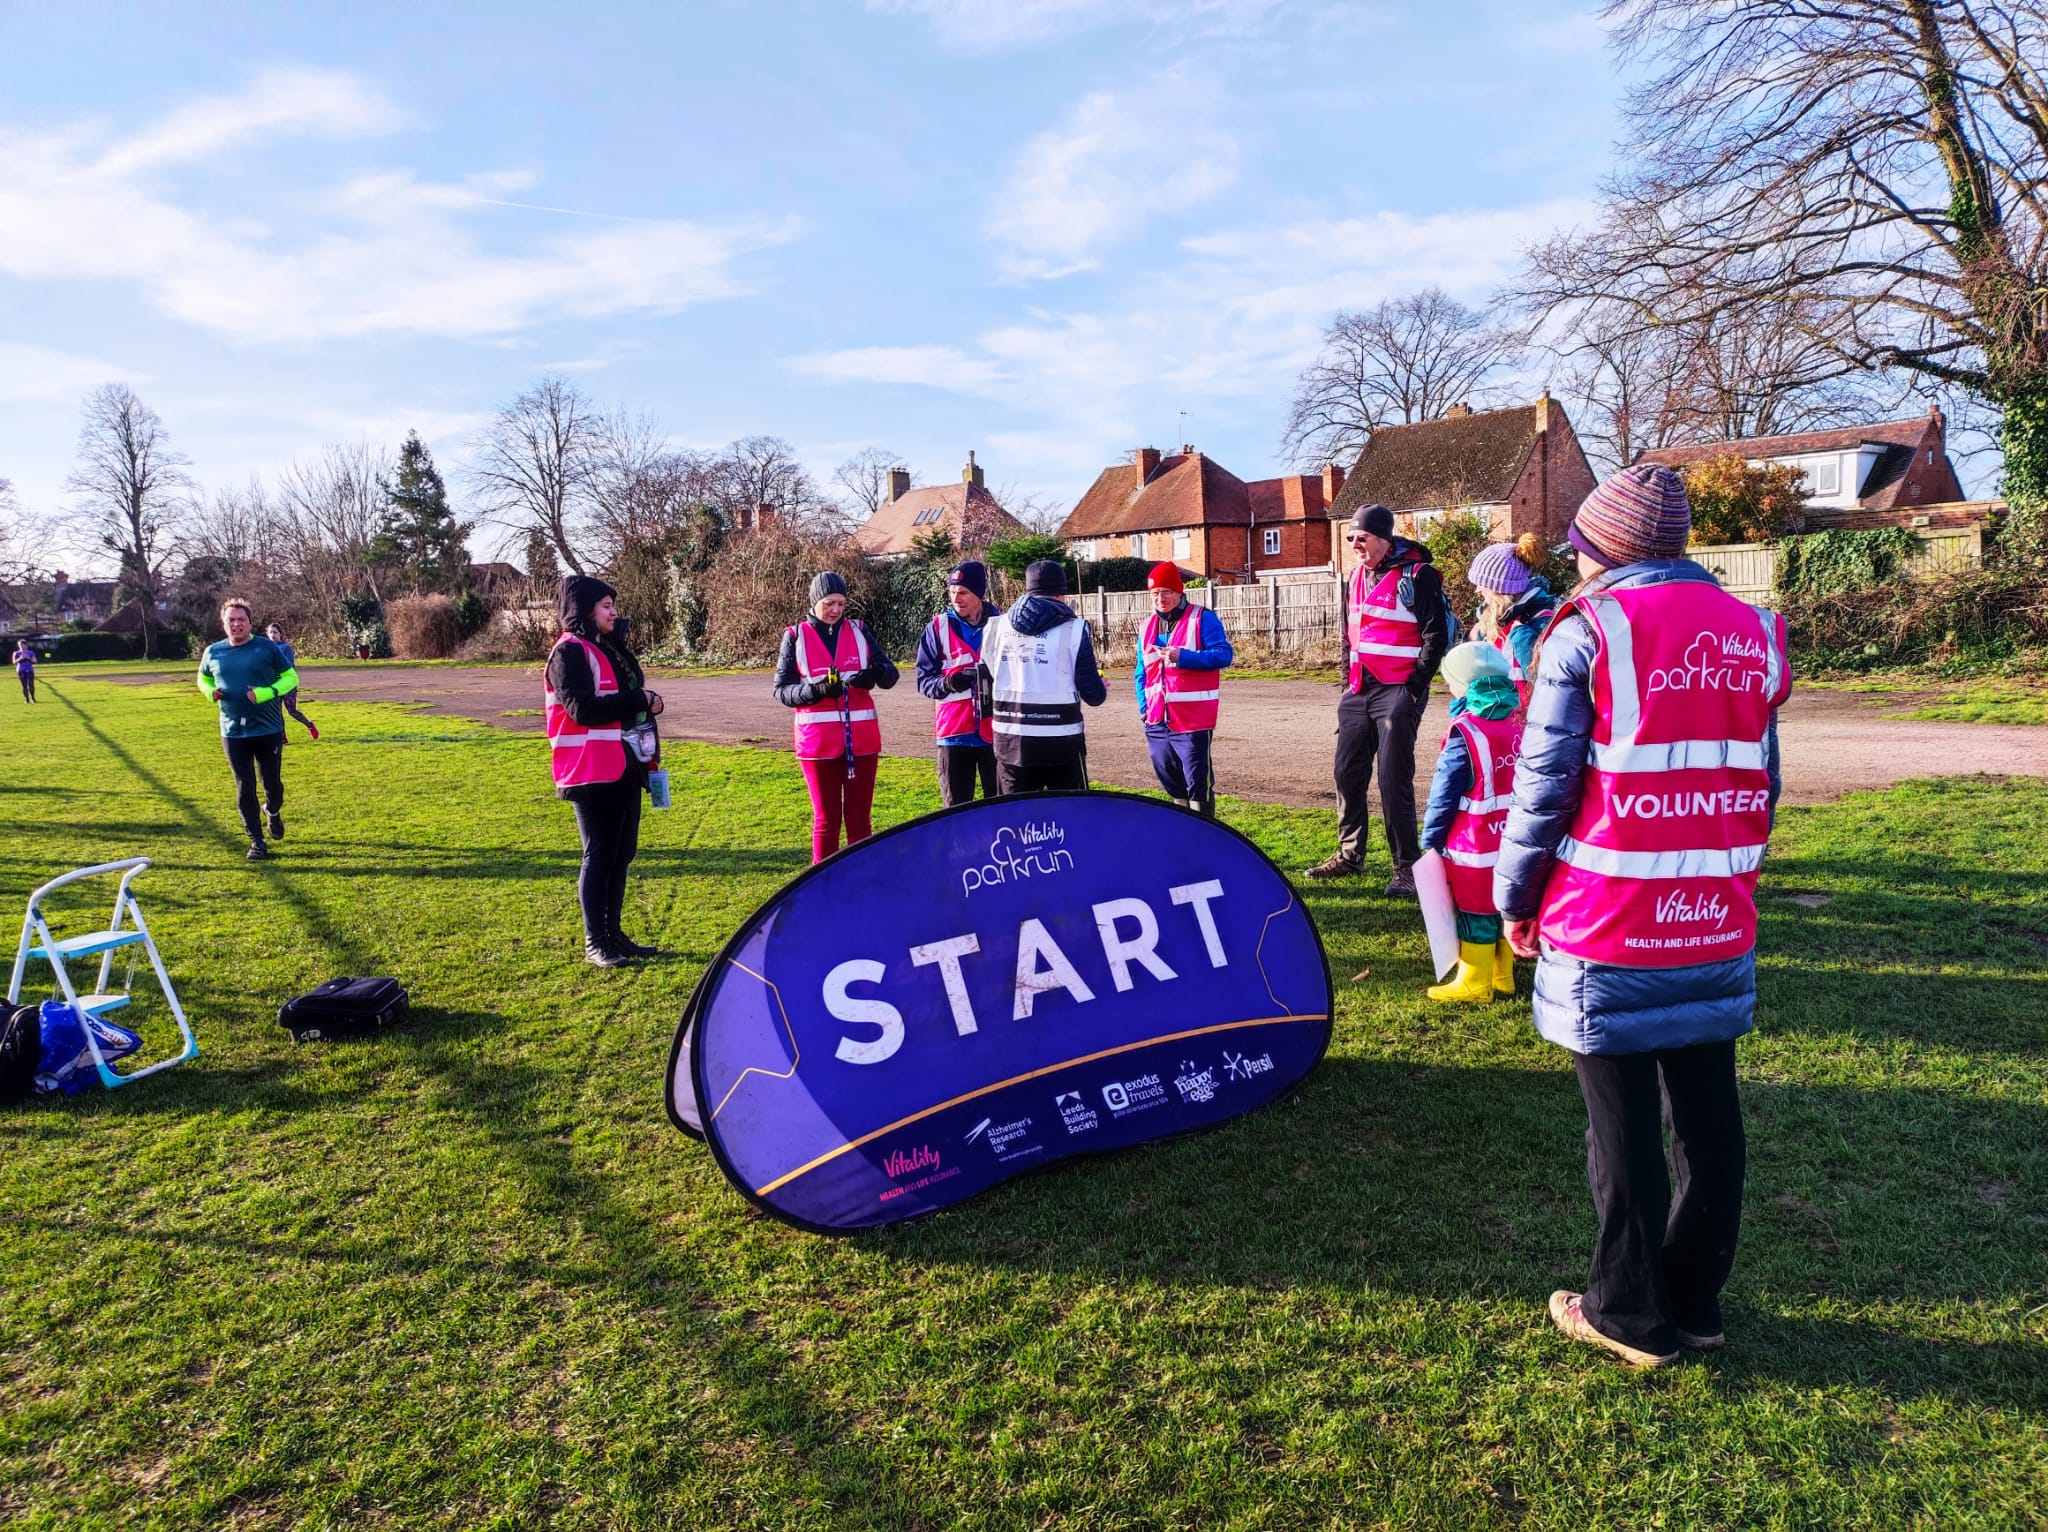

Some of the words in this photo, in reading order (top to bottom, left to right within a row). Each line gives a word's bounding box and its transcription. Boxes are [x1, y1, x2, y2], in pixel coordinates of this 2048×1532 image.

[1722, 632, 1766, 665] Vitality
[1646, 650, 1766, 700] parkrun
[1611, 789, 1770, 819] VOLUNTEER
[1019, 821, 1064, 844] Vitality
[963, 845, 1074, 898] parkrun
[1655, 888, 1729, 930] Vitality
[1625, 937, 1662, 948] HEALTH
[1664, 937, 1682, 948] AND
[1684, 937, 1701, 947] LIFE
[1703, 929, 1743, 945] INSURANCE
[822, 879, 1229, 1065] START
[1243, 1053, 1274, 1079] Persil
[1125, 1074, 1160, 1091] exodus
[1174, 1066, 1213, 1095] happy
[1130, 1085, 1164, 1102] travels
[1190, 1085, 1214, 1102] egg
[1060, 1103, 1085, 1116] Leeds
[1063, 1110, 1096, 1125] Building
[988, 1117, 1032, 1137] Alzheimer's
[990, 1128, 1026, 1146] Research
[1067, 1119, 1098, 1134] Society
[994, 1144, 1006, 1153] UK
[883, 1144, 940, 1178] Vitality
